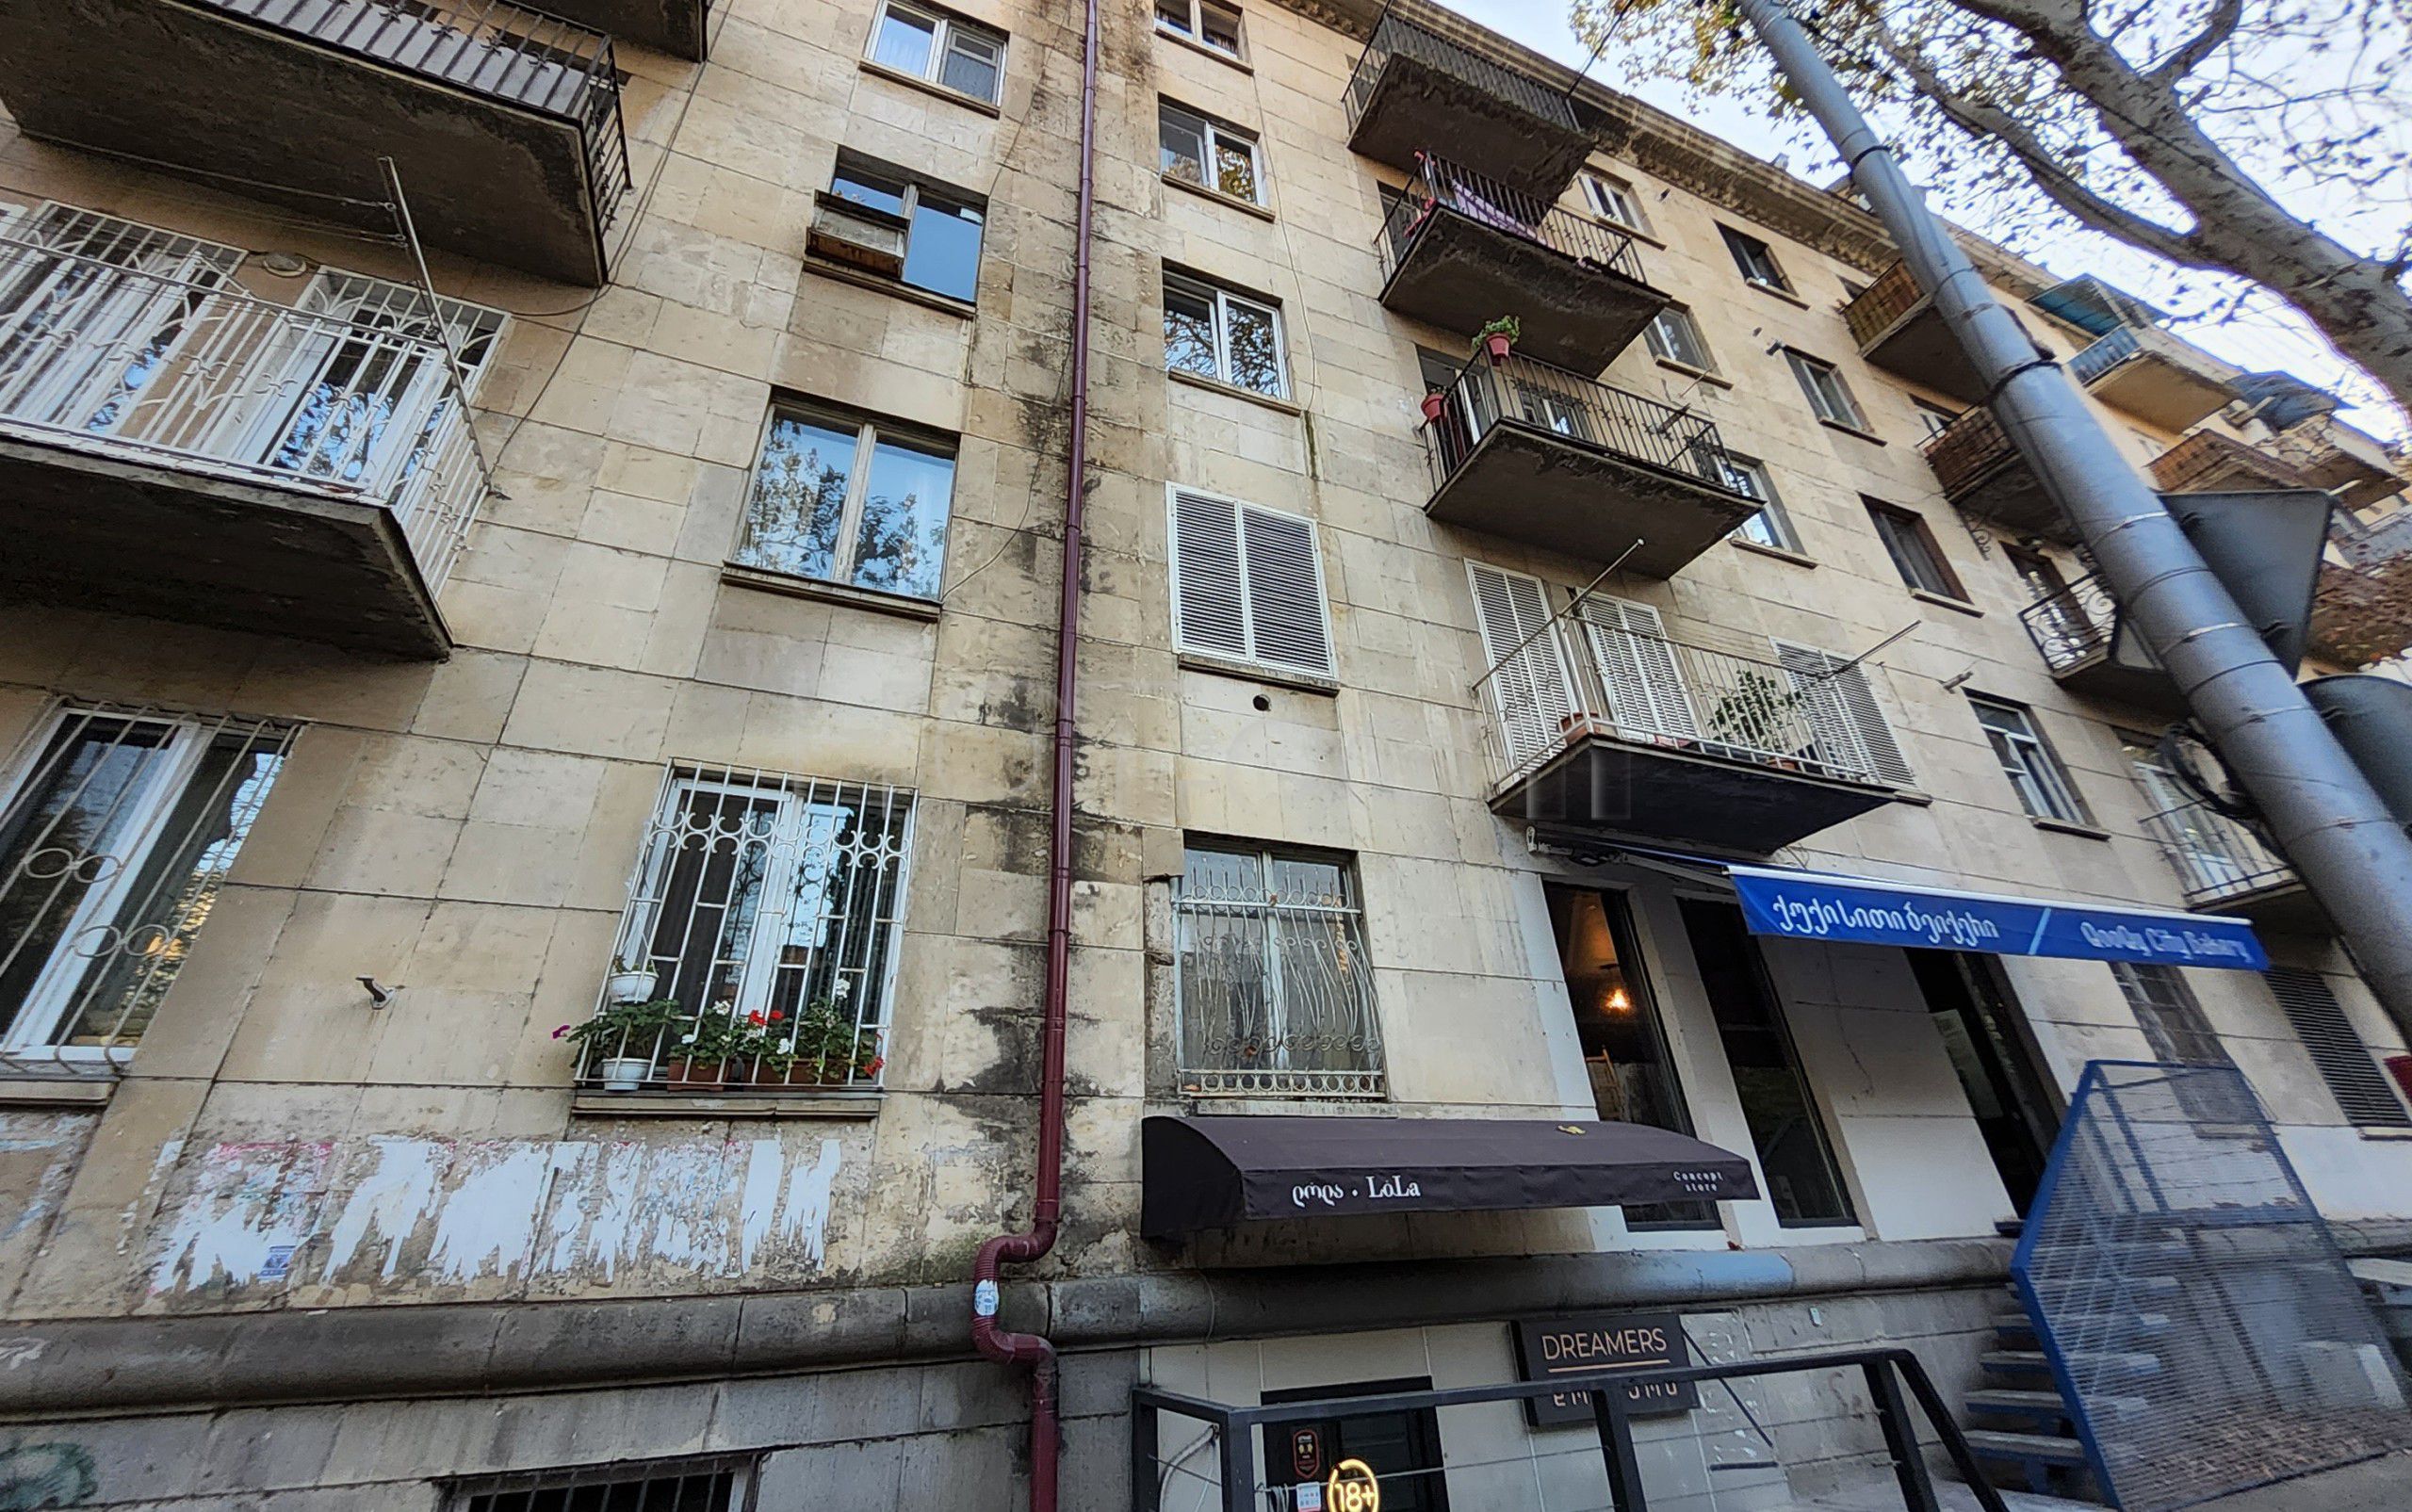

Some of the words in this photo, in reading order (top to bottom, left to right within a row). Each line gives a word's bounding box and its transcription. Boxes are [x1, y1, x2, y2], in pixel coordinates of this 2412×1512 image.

[1672, 1171, 1724, 1182] Concept
[1540, 1327, 1668, 1360] DREAMERS
[1334, 1481, 1376, 1512] 18+
